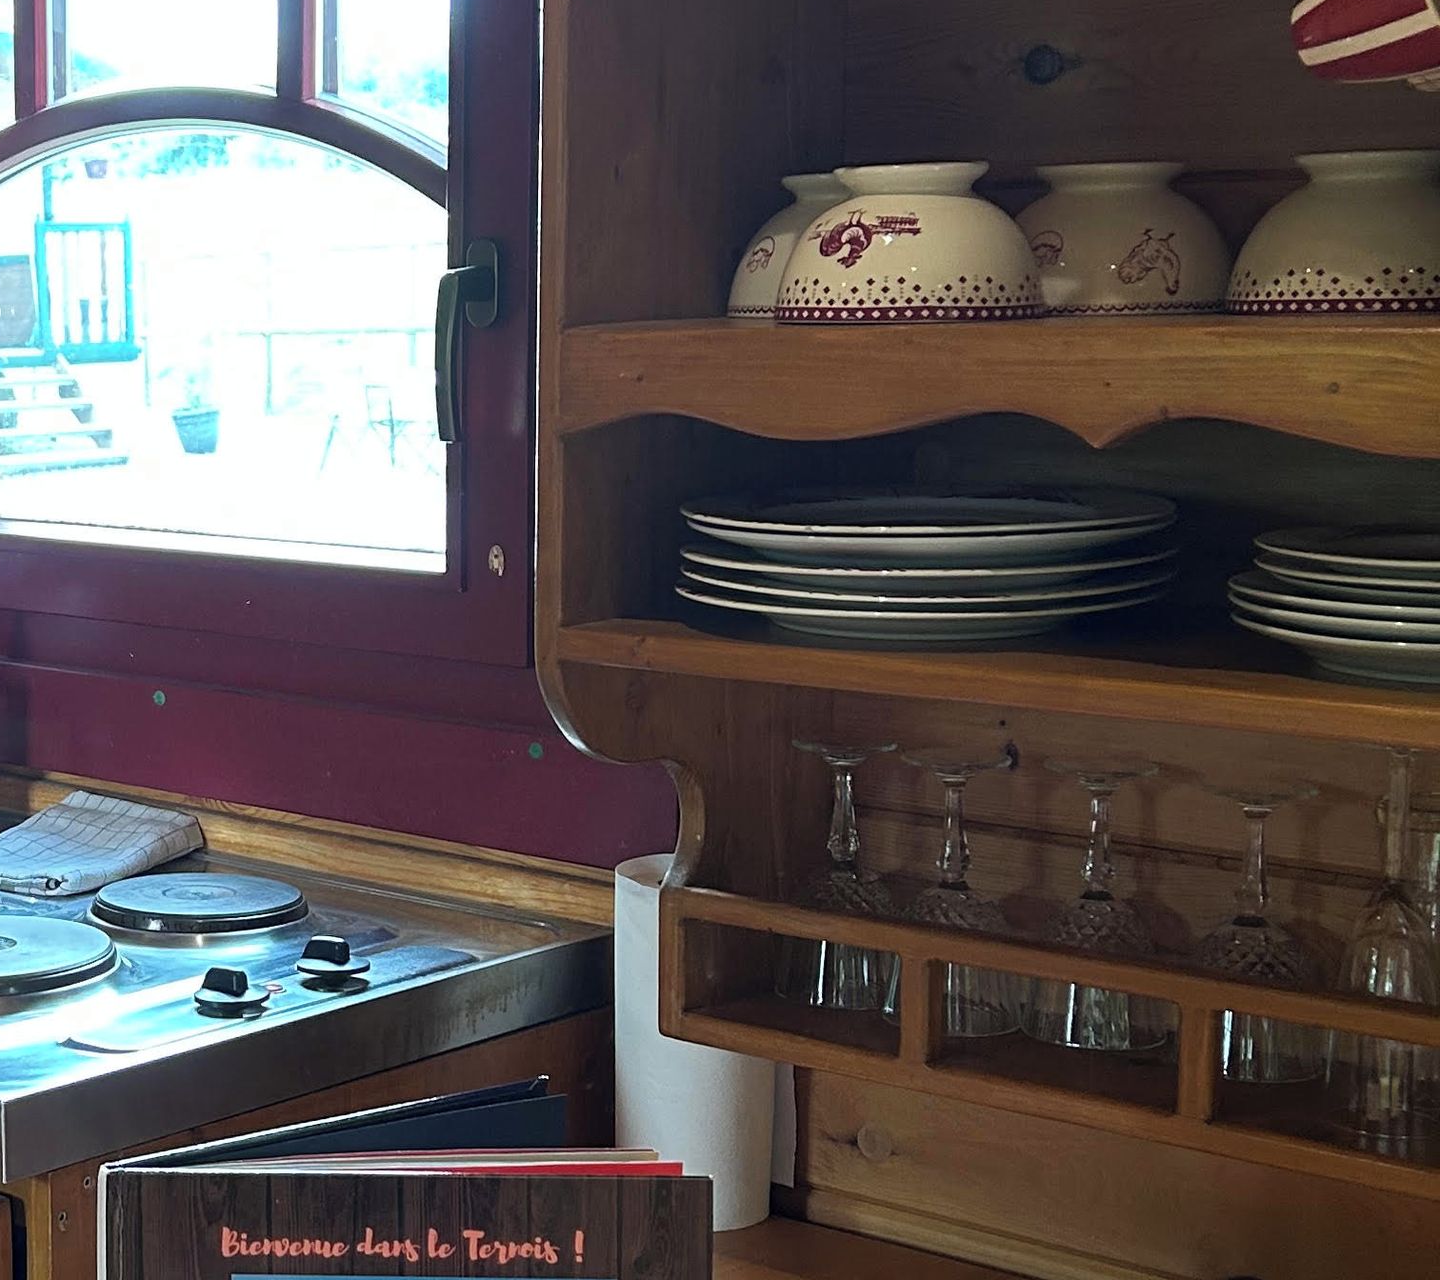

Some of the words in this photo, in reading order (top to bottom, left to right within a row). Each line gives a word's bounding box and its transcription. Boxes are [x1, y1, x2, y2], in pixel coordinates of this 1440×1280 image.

[221, 1226, 349, 1258] Bienvenue
[357, 1228, 420, 1262] dans
[427, 1228, 456, 1258] le
[462, 1229, 560, 1264] Ternois
